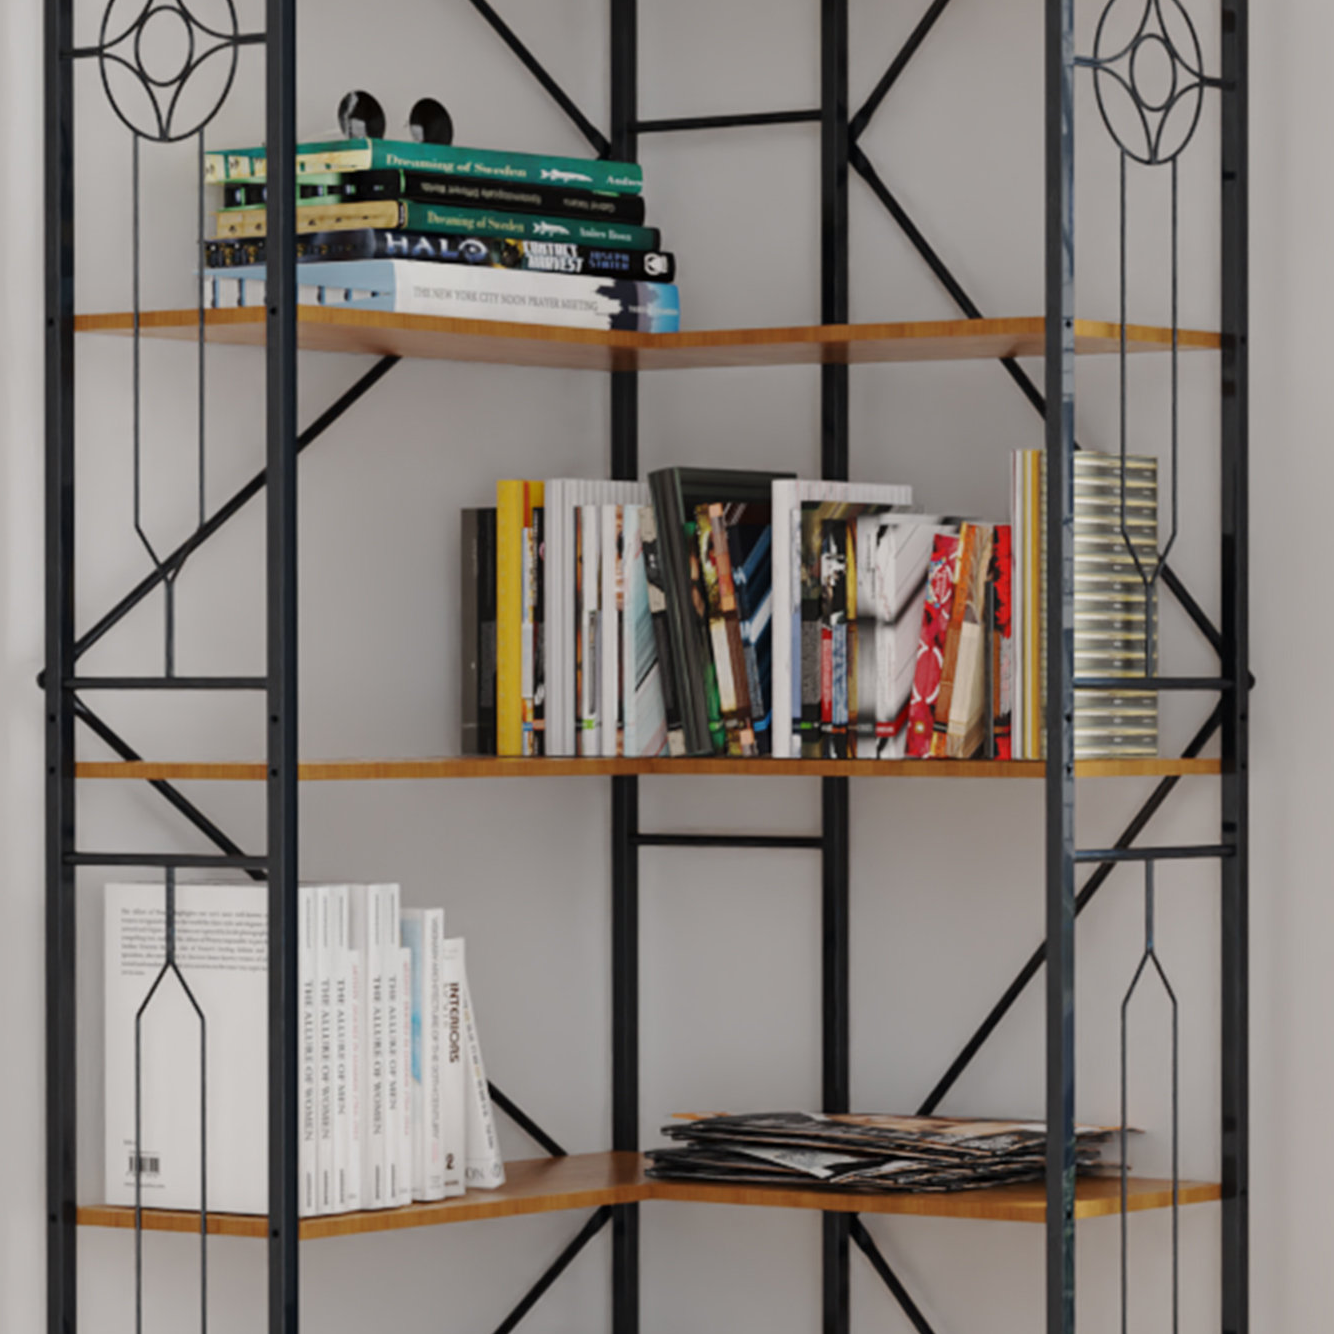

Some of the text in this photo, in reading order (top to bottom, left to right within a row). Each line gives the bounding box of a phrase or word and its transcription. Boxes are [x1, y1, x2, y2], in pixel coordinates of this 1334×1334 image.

[386, 153, 454, 174] Dreaming
[456, 160, 472, 173] of
[474, 163, 527, 178] Sweden
[427, 209, 475, 230] Dreaming
[476, 216, 487, 228] of
[487, 218, 525, 233] Sweden
[385, 231, 488, 263] HALO
[413, 285, 431, 299] THE
[432, 287, 453, 301] NEW
[454, 288, 478, 303] YORK
[478, 291, 500, 305] CITY
[449, 982, 460, 1063] INTERIORS
